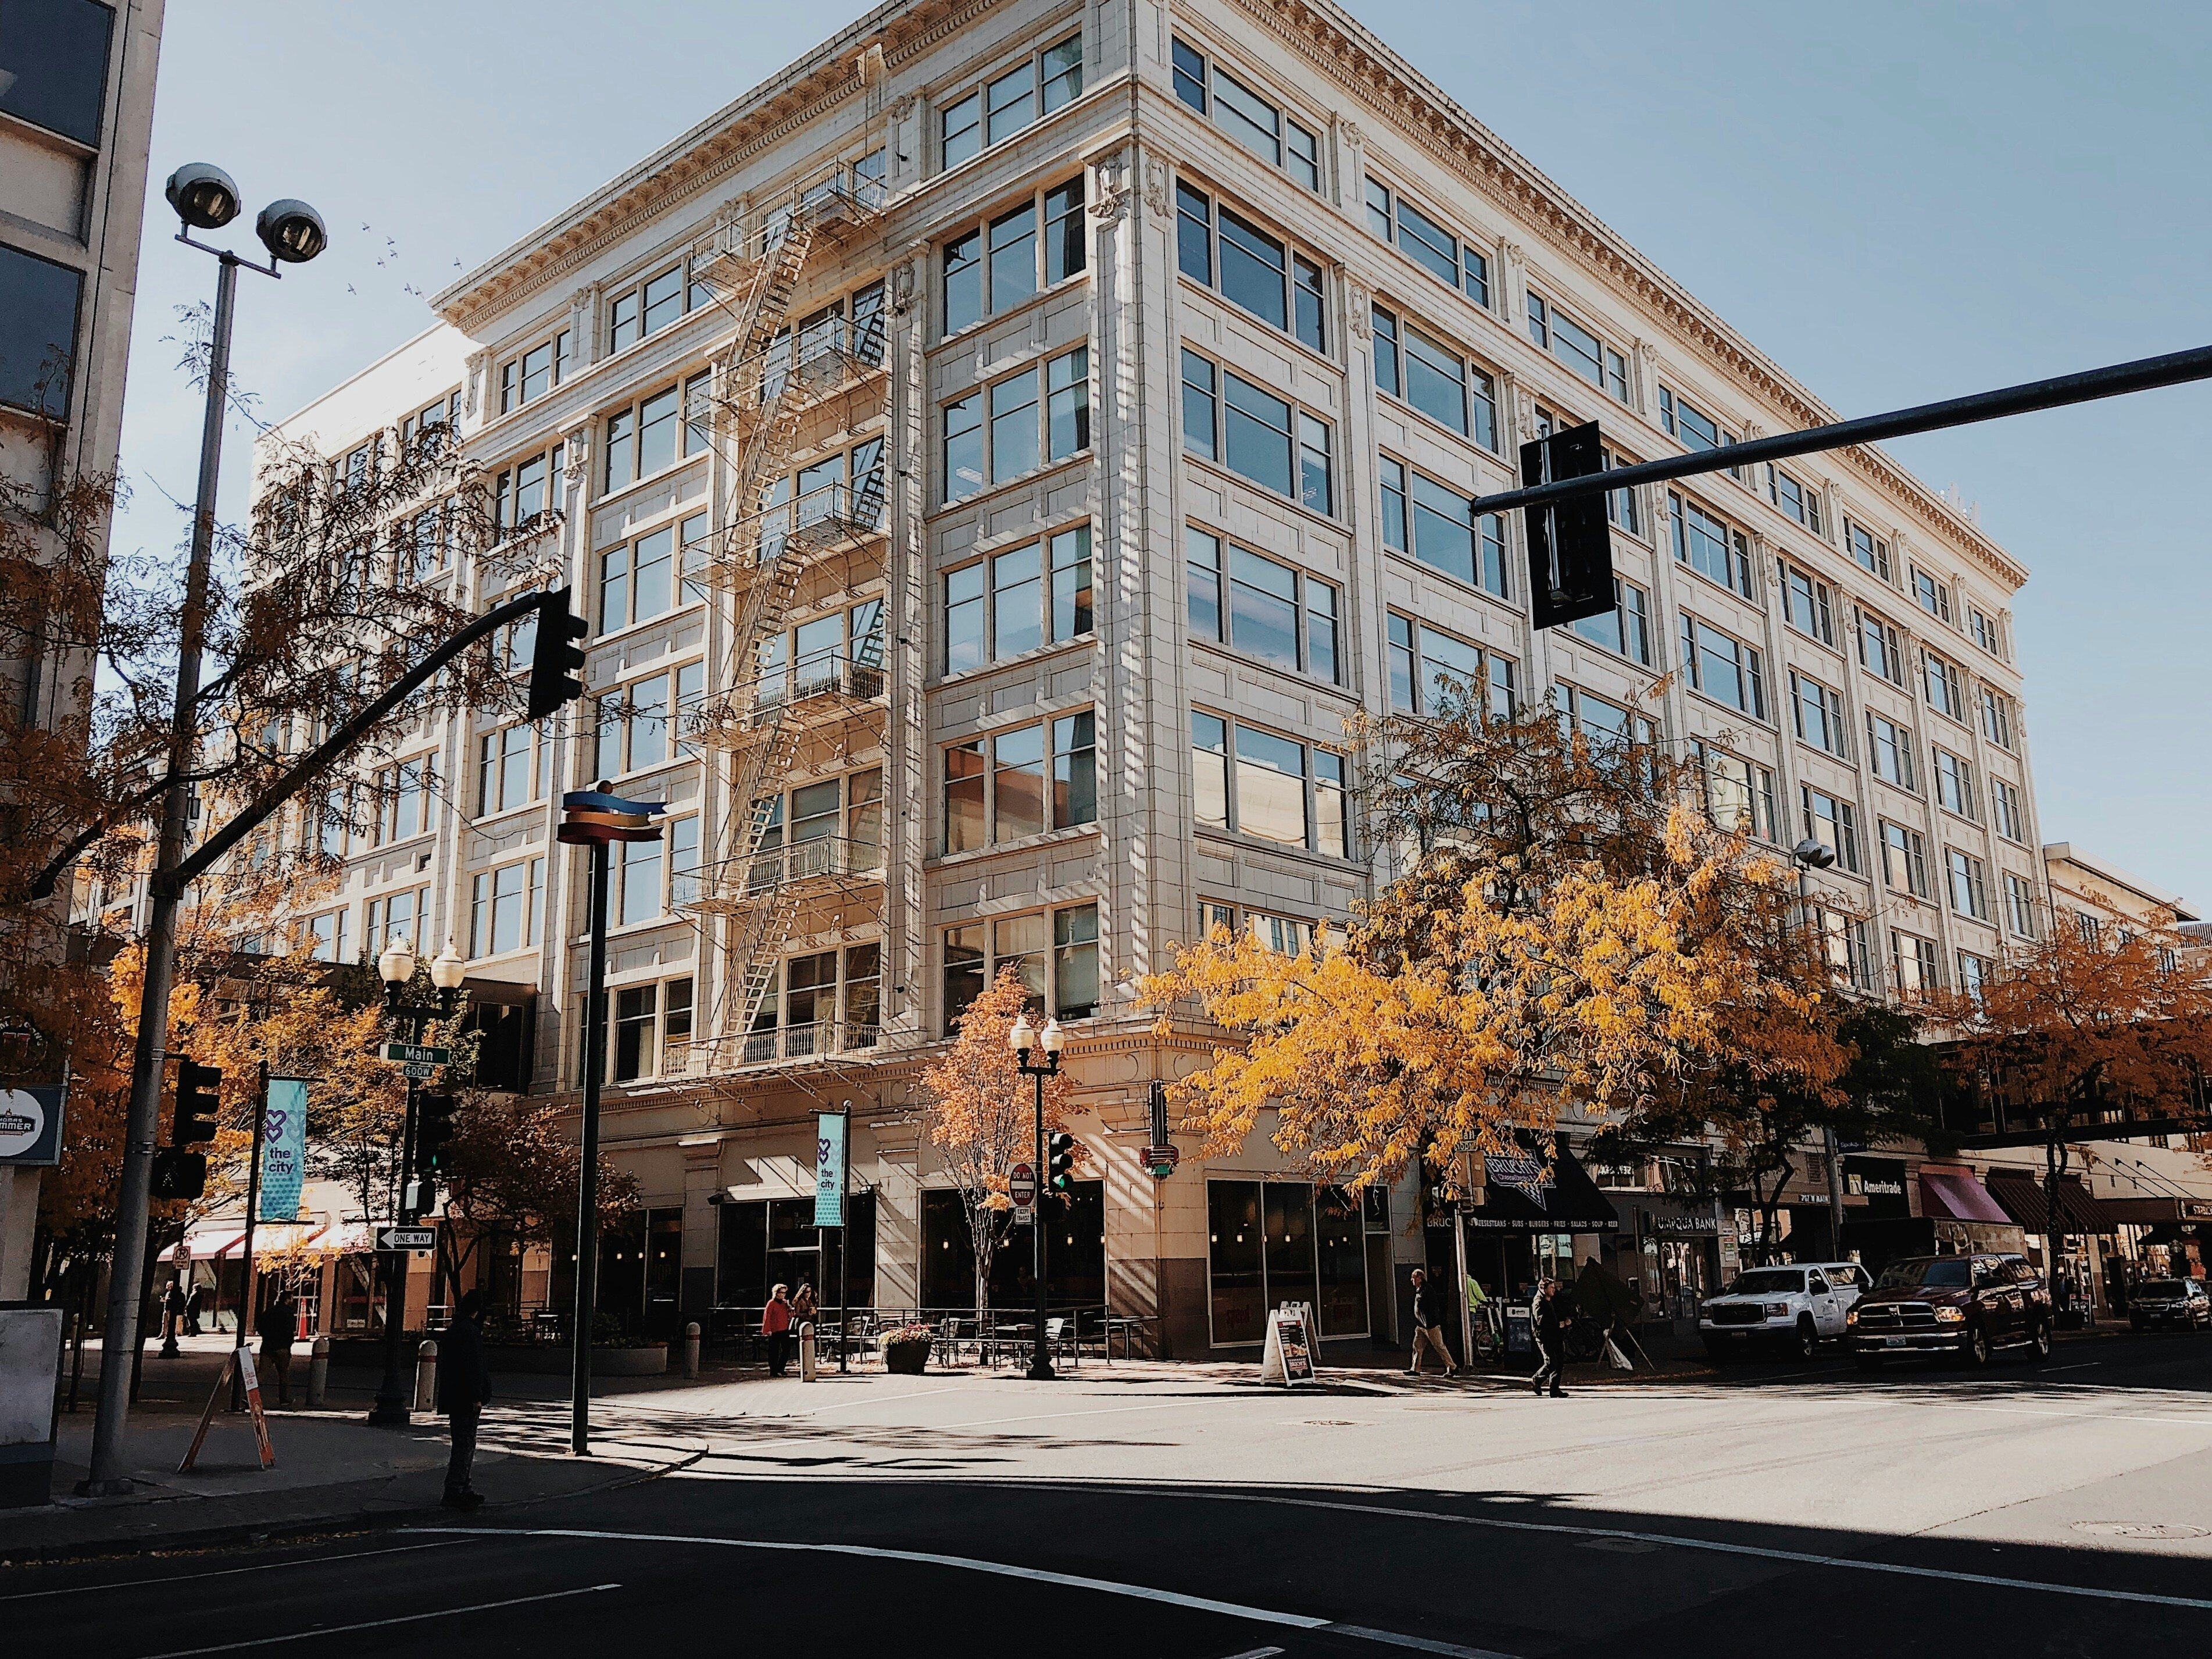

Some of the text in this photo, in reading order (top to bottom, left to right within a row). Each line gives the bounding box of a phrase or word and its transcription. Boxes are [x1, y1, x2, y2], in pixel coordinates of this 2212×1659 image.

[405, 1047, 433, 1061] Main
[405, 1066, 430, 1076] 600W
[1462, 1129, 1475, 1140] all
[269, 1147, 291, 1158] the
[269, 1161, 294, 1175] city
[1486, 1159, 1541, 1173] BRUCHI'S
[821, 1168, 833, 1178] the
[820, 1179, 835, 1190] city
[1864, 1180, 1902, 1195] Ameritrade
[1427, 1218, 1452, 1227] BRUC
[1657, 1216, 1716, 1230] UMPQUA BANK
[394, 1234, 430, 1243] ONE WAY
